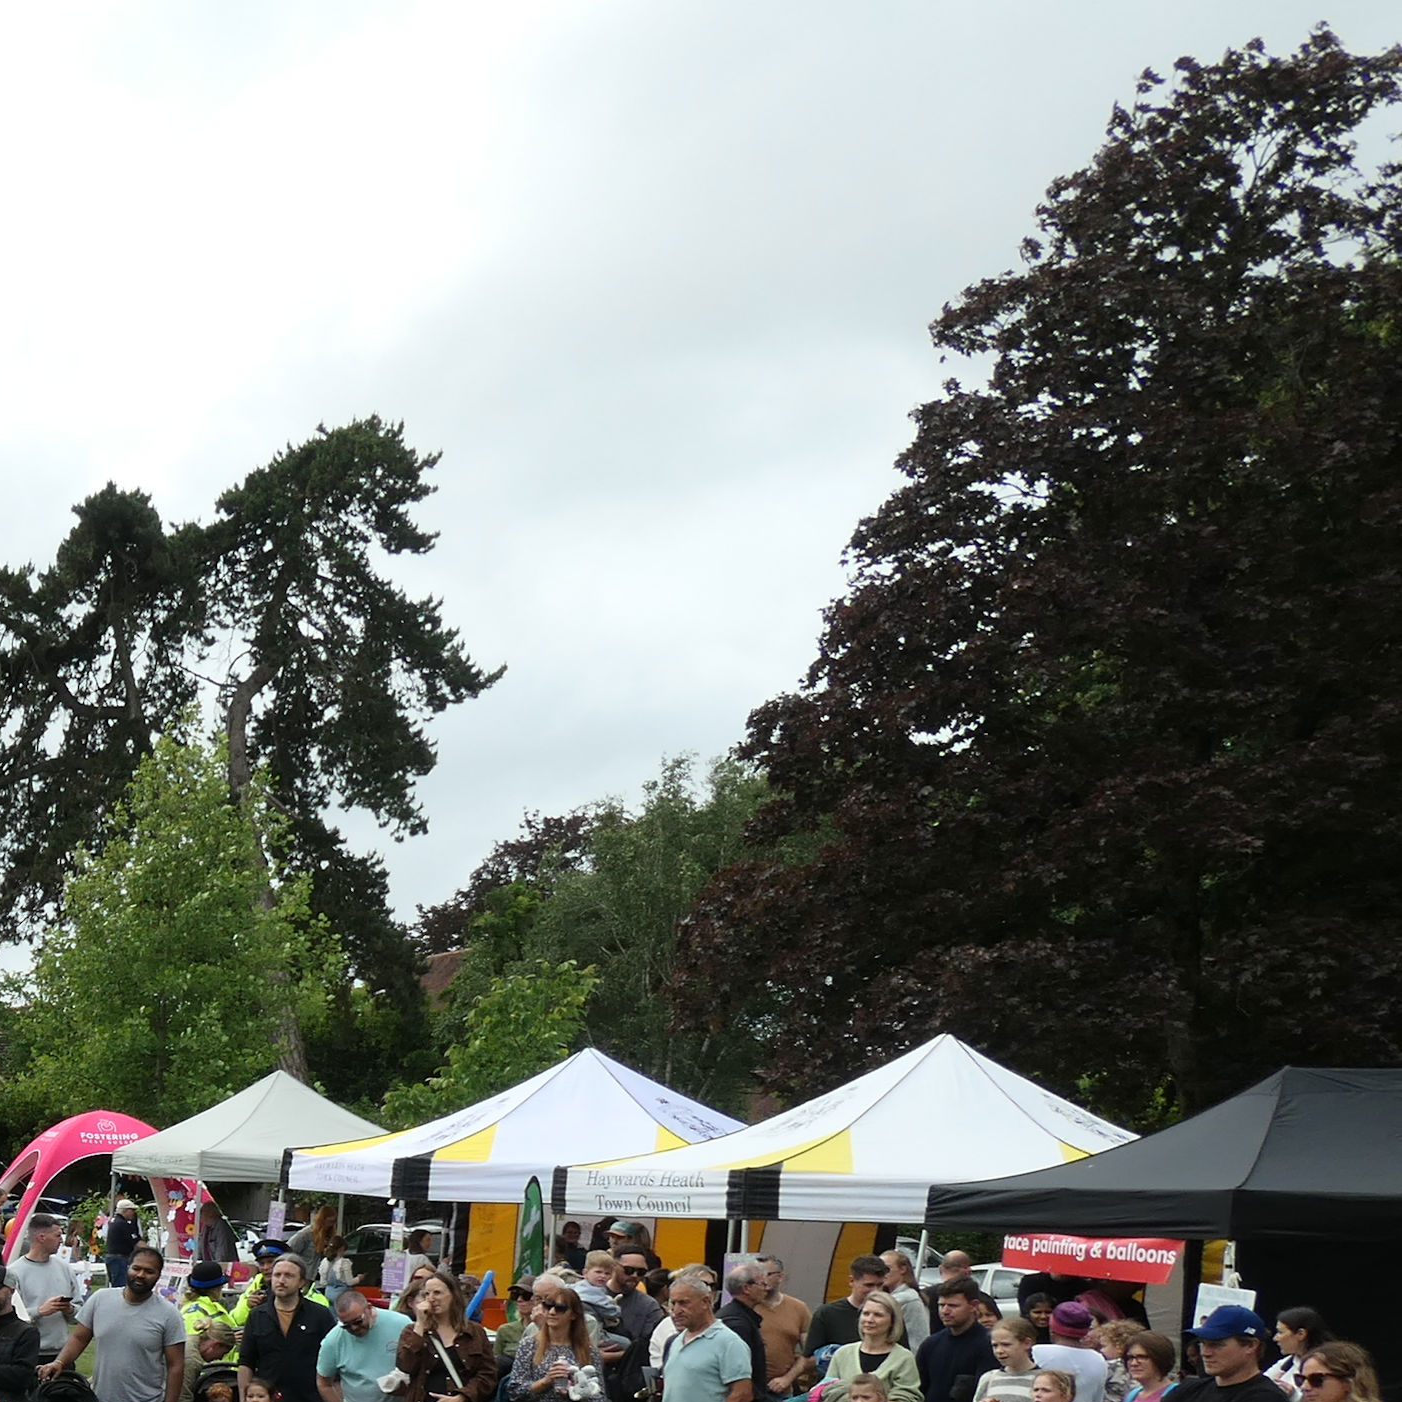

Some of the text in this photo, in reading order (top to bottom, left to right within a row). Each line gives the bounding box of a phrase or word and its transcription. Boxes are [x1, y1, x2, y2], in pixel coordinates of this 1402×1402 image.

[80, 1132, 139, 1141] FOSTERING
[586, 1170, 704, 1189] Haywards Heath
[595, 1194, 692, 1213] Town Council
[1031, 1236, 1087, 1261] painting
[1089, 1241, 1102, 1259] &
[1106, 1241, 1177, 1264] balloons
